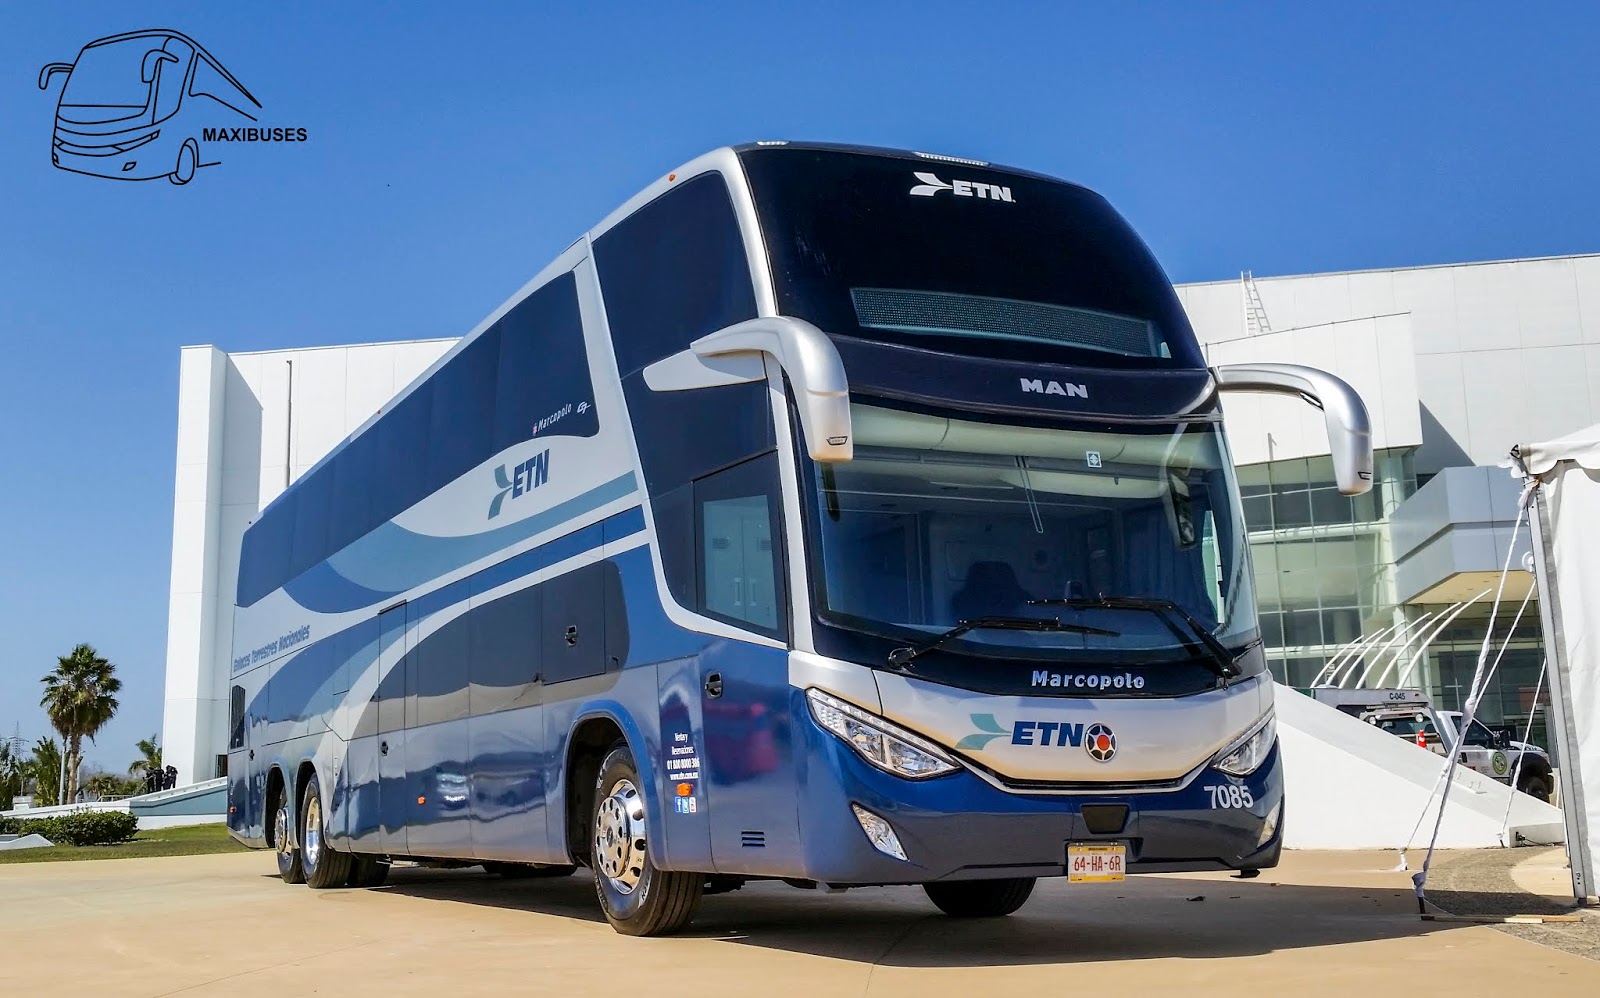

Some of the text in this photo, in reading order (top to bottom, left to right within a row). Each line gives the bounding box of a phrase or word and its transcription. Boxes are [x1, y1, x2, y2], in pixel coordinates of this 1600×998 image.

[952, 179, 1013, 203] ETN
[1020, 378, 1088, 399] MAN
[538, 403, 572, 431] Marcopolo
[512, 448, 550, 499] ETN
[1031, 670, 1145, 690] Marcopolo
[1389, 692, 1406, 700] C-045
[1011, 721, 1085, 748] ETN
[1203, 785, 1254, 809] 7085
[1074, 855, 1121, 871] 64-HA-6R
